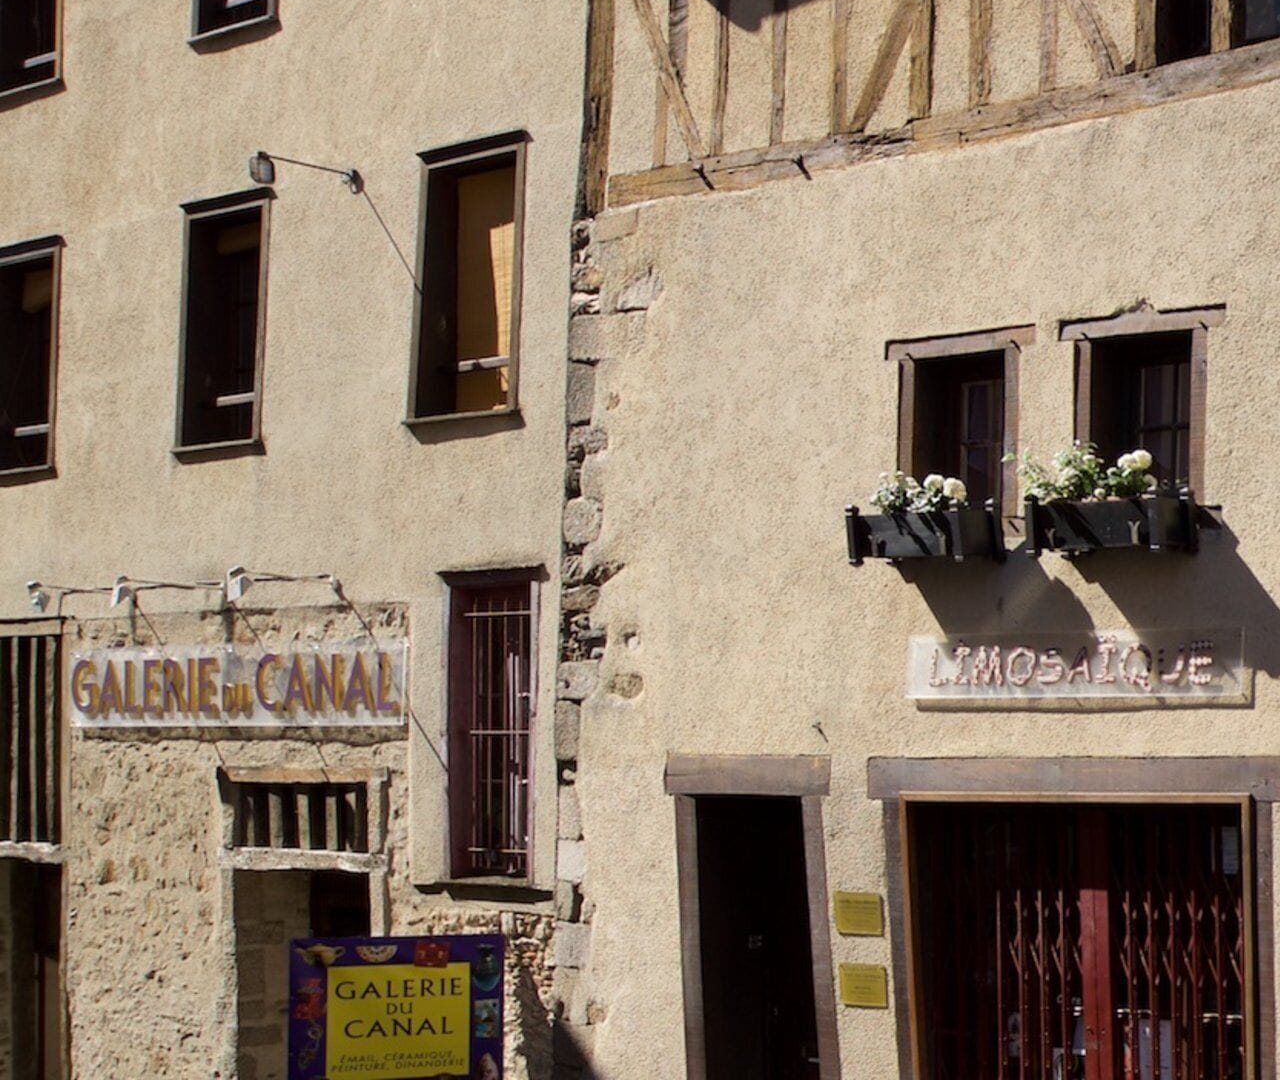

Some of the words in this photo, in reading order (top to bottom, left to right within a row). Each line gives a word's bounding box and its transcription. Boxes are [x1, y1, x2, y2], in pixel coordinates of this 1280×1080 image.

[71, 657, 221, 714] GALERIE
[255, 651, 400, 713] CANAL
[335, 977, 464, 1000] GALERIE
[386, 1002, 414, 1016] DU
[344, 1016, 453, 1039] CANAL
